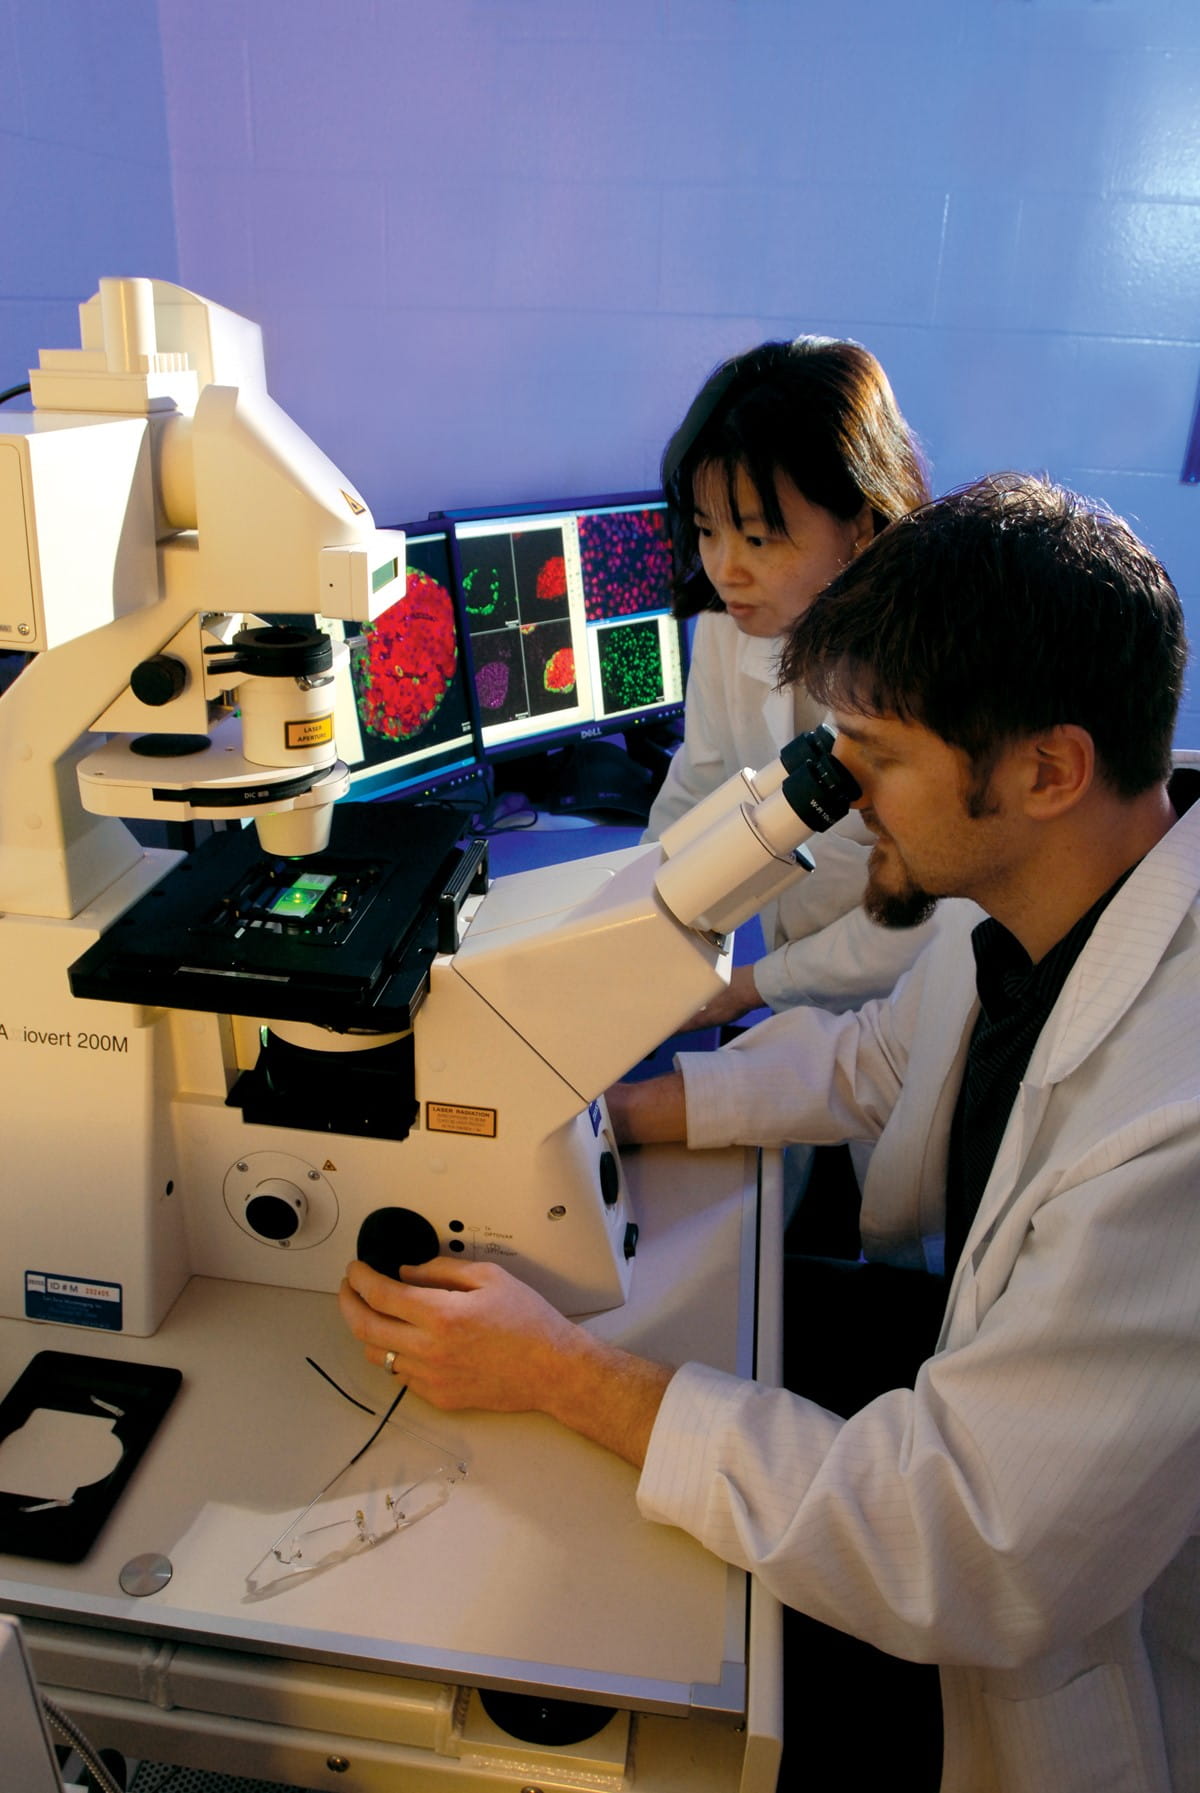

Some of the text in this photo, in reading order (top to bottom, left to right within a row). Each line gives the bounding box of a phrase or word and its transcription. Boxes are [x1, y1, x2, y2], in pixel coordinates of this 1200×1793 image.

[580, 727, 603, 740] DELL
[77, 1032, 128, 1053] 200M
[432, 1106, 490, 1118] LASER RADIATION
[50, 1282, 60, 1290] ID
